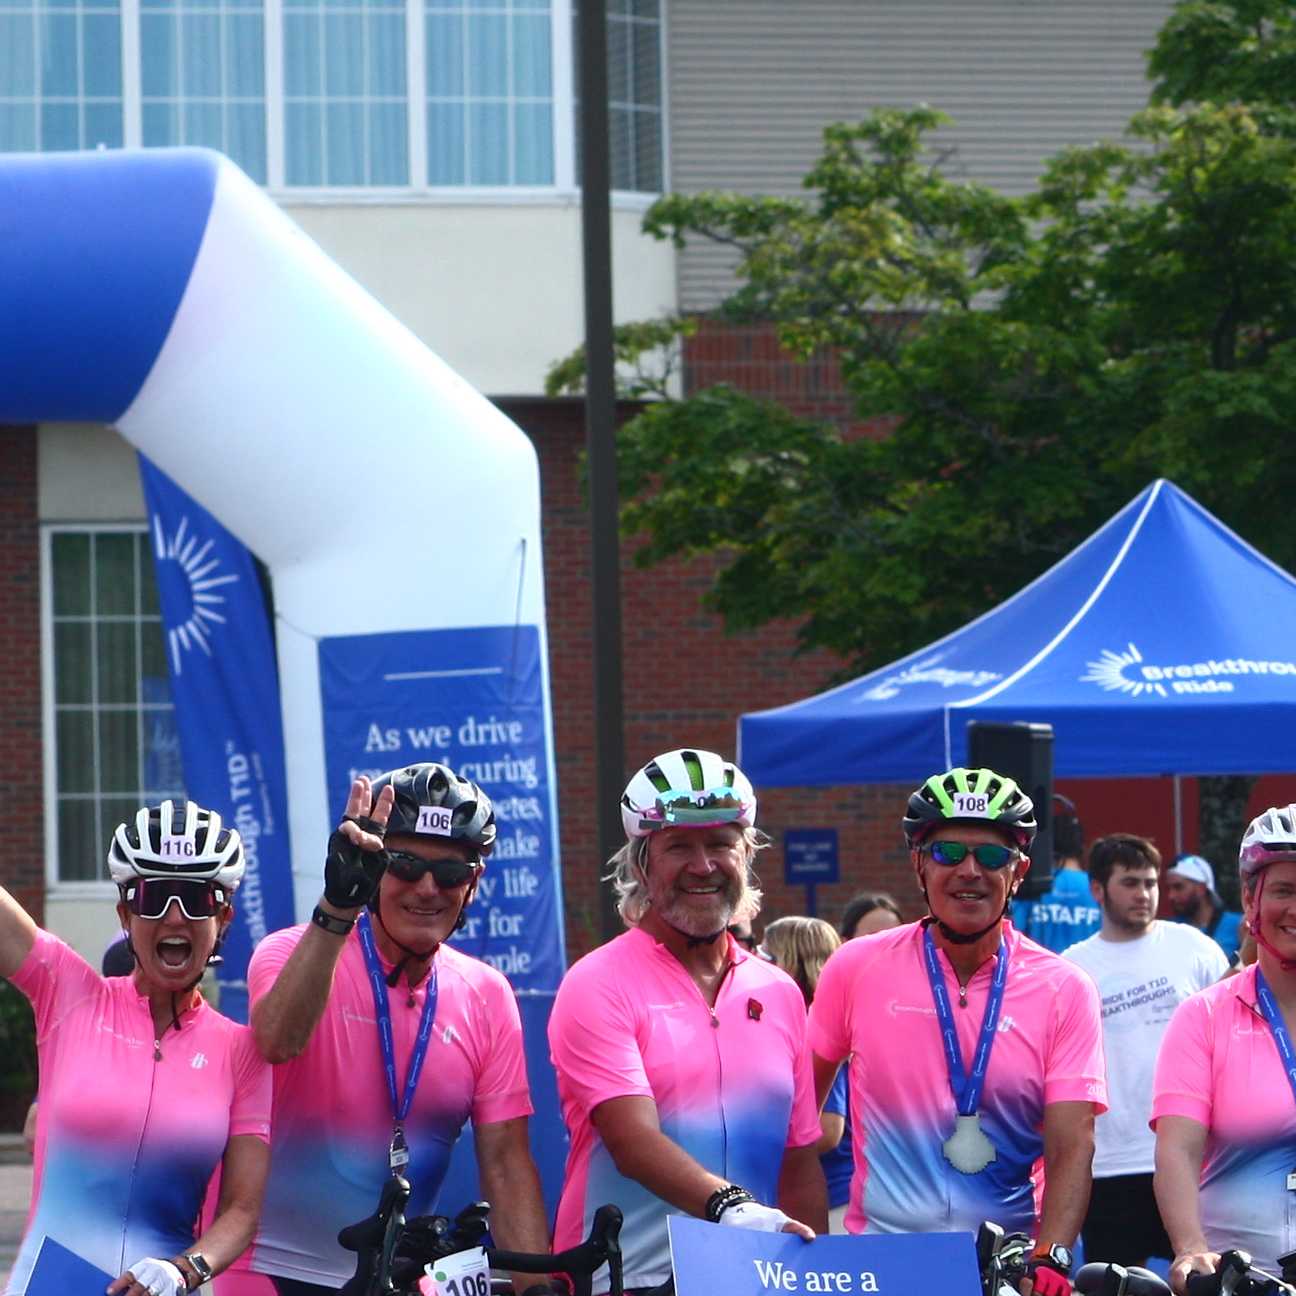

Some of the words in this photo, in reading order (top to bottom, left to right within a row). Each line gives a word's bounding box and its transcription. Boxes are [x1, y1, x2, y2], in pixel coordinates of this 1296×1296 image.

[1172, 681, 1233, 693] Ride
[364, 723, 401, 751] As
[407, 724, 450, 748] we
[458, 716, 523, 745] drive
[461, 754, 537, 788] curing
[957, 797, 986, 813] 108
[421, 811, 450, 831] 106
[503, 866, 538, 898] life
[489, 907, 524, 937] for
[1031, 904, 1099, 925] STAFF
[1127, 984, 1146, 997] FOR
[753, 1260, 797, 1290] We
[805, 1272, 851, 1292] are
[861, 1272, 879, 1291] a
